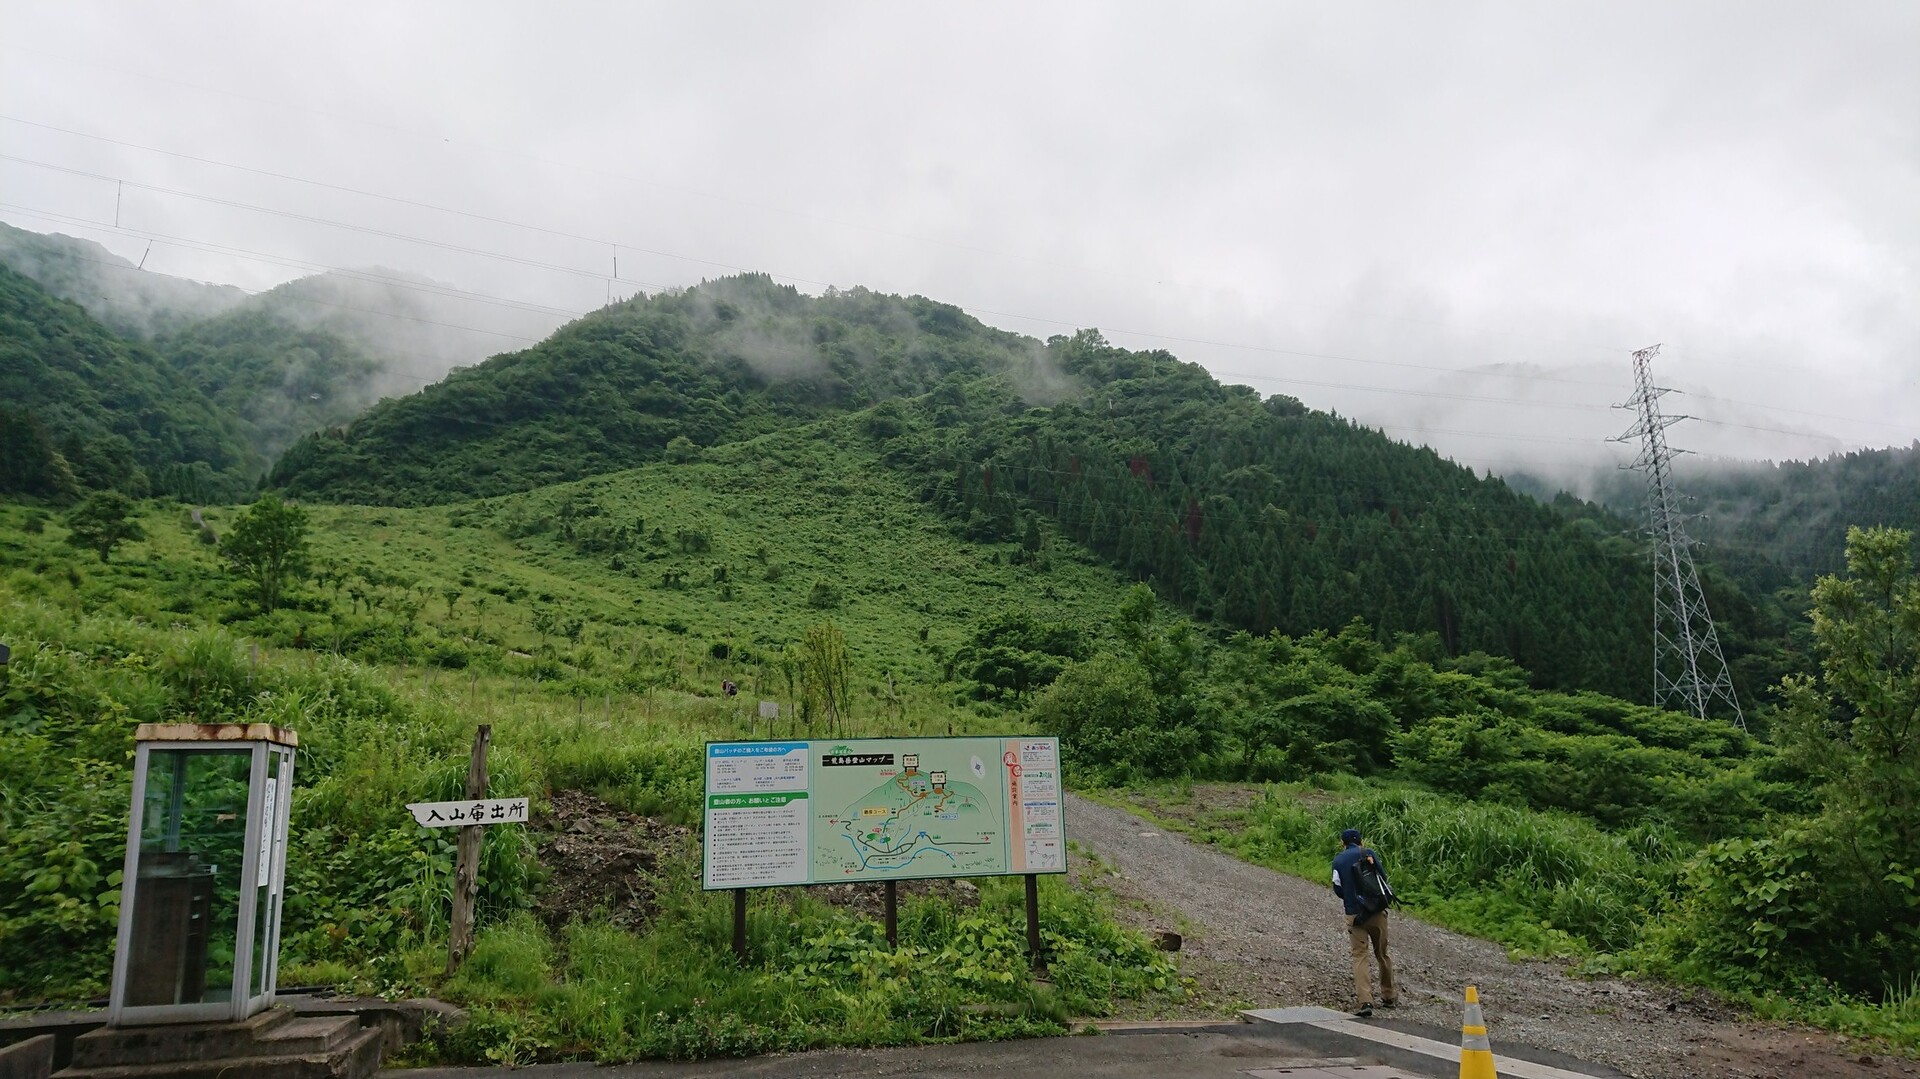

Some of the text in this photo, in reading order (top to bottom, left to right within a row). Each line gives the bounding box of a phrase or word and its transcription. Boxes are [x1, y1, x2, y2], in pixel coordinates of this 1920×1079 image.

[426, 802, 525, 822] 入山届出所
